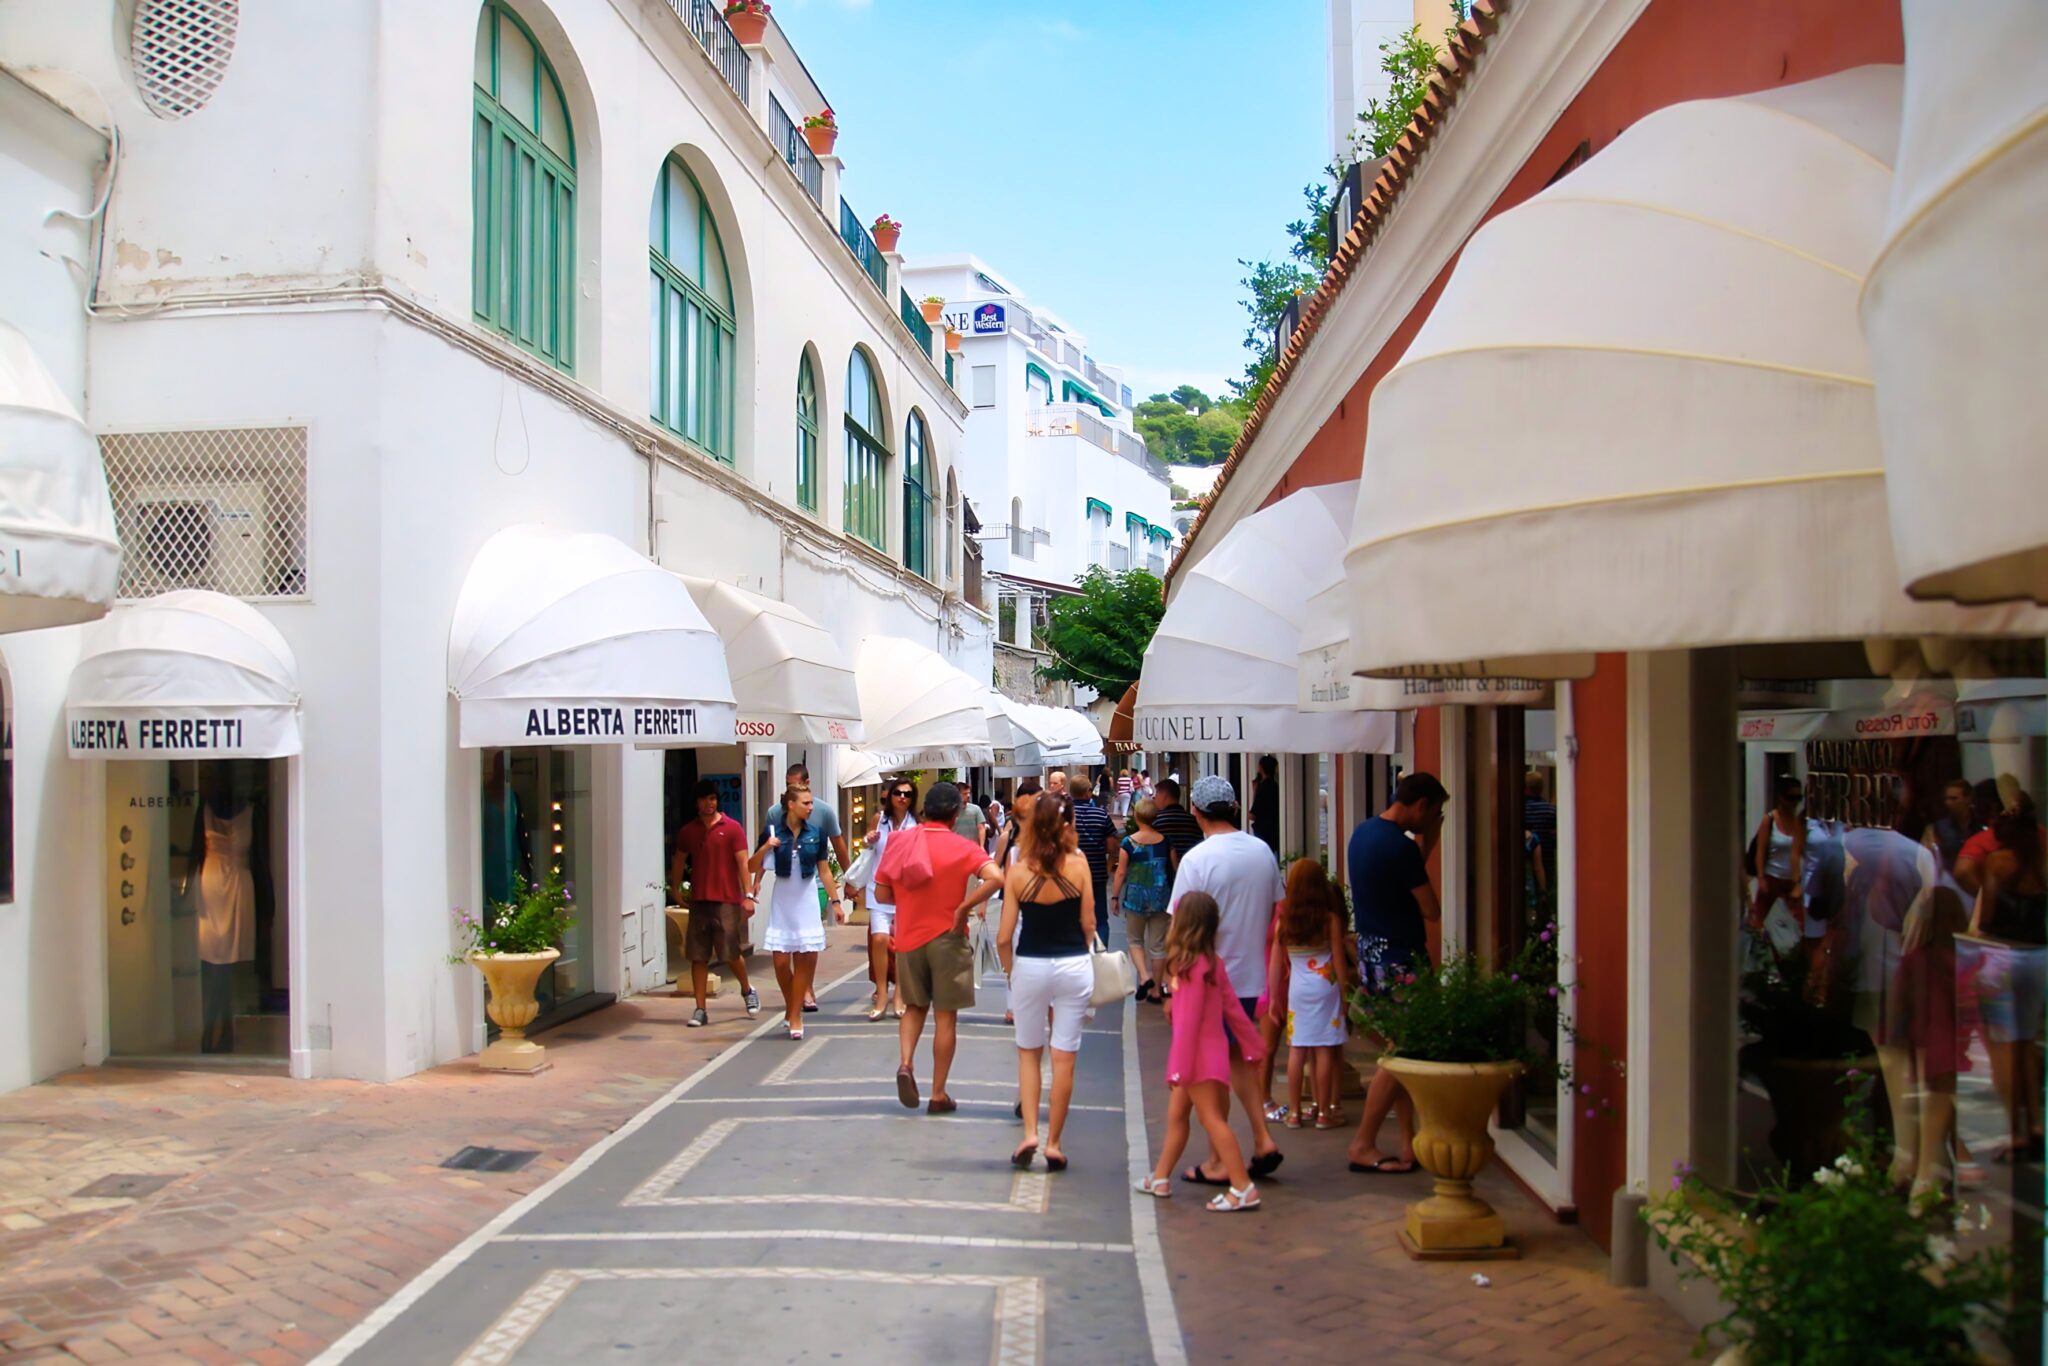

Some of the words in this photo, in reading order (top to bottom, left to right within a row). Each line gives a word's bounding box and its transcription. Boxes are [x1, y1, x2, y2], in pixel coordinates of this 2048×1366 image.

[940, 312, 969, 330] NE
[975, 321, 1004, 329] Western
[981, 313, 997, 322] Best
[525, 708, 625, 737] ALBERTA
[634, 708, 698, 736] FERRETTI
[139, 719, 242, 749] FERRETTI
